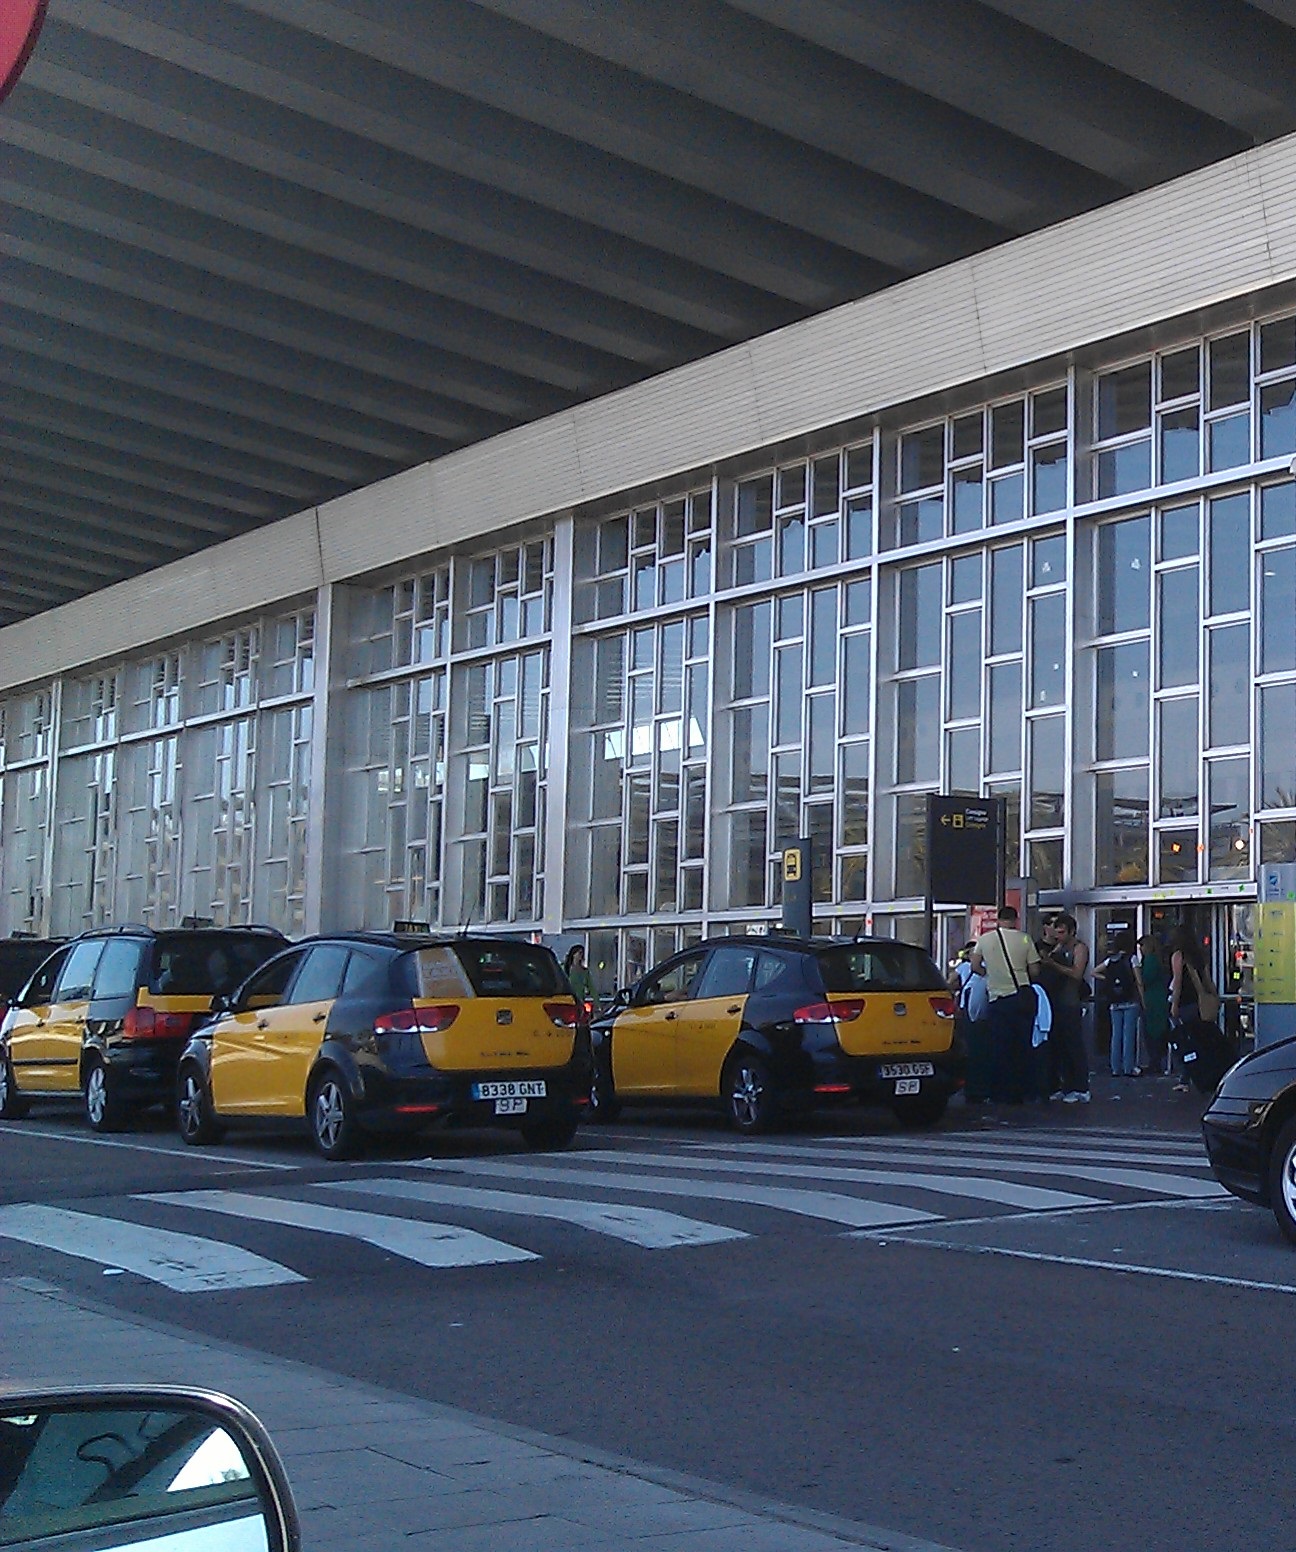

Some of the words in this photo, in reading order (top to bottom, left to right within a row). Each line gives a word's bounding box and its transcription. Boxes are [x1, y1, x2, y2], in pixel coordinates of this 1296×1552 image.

[481, 1083, 516, 1098] 8338
[519, 1082, 545, 1096] GNT
[899, 1080, 918, 1093] SP
